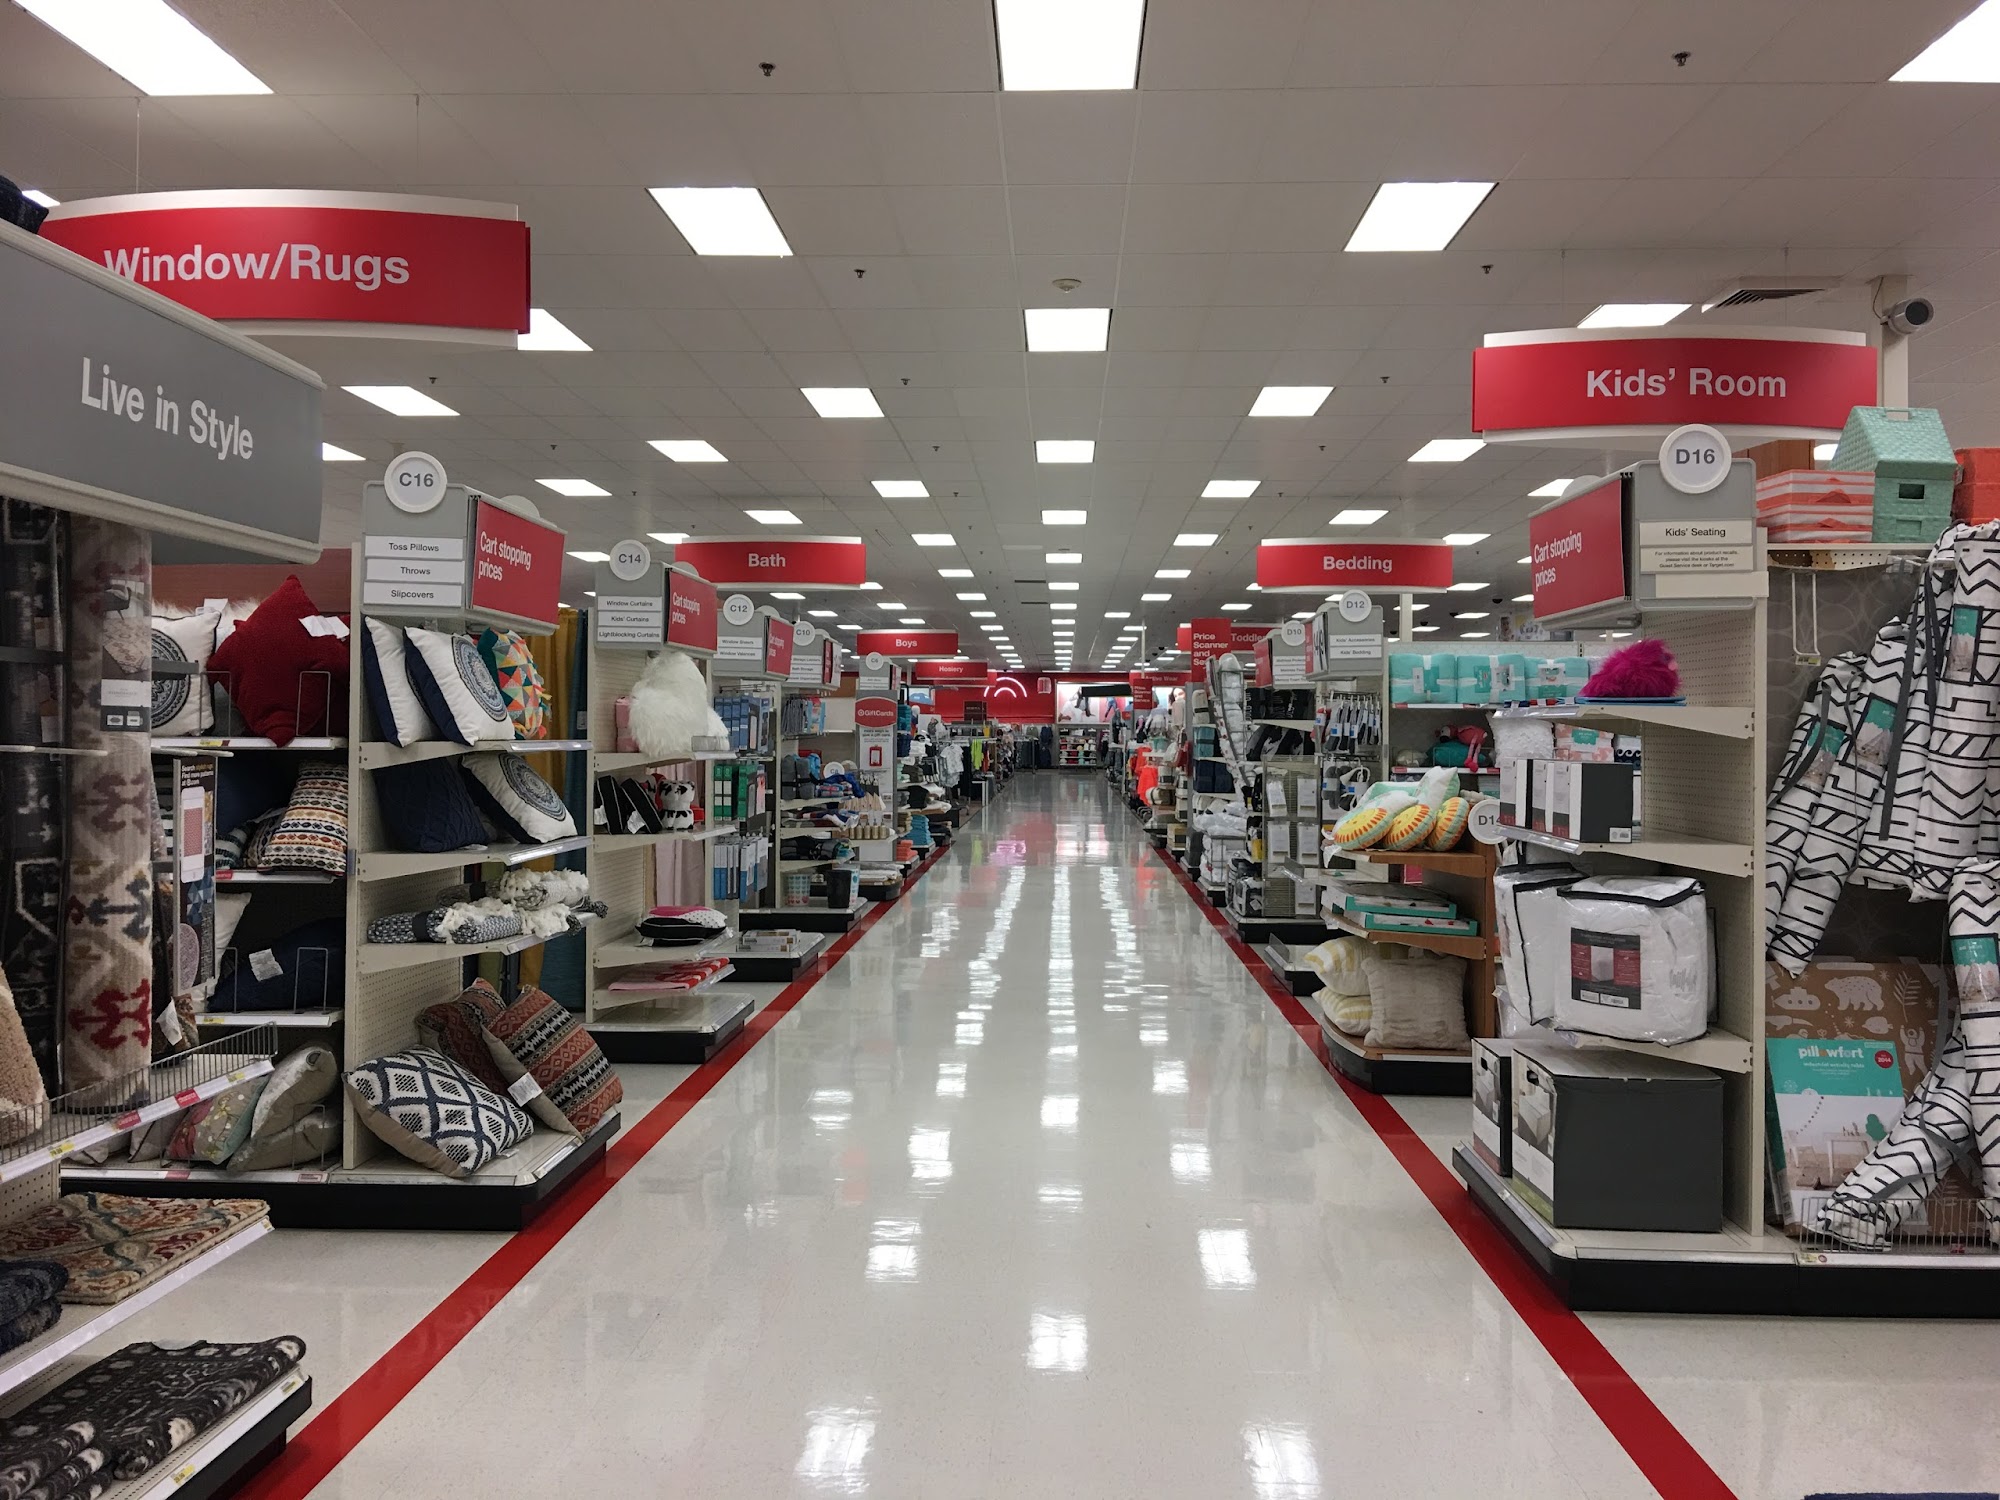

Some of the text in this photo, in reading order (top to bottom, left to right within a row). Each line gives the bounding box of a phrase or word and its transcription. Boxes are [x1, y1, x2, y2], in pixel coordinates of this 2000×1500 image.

[103, 243, 410, 291] Window/Rugs
[1586, 367, 1786, 398] Kids’ Room
[81, 357, 253, 461] Live in Style
[1675, 449, 1715, 465] D16
[399, 472, 434, 487] C16
[1665, 527, 1726, 538] Kids' Seating
[388, 542, 440, 552] Toss Pillows
[480, 531, 532, 572] Cart stopping
[1534, 530, 1582, 564] Cart stopping
[618, 553, 641, 564] C14
[748, 553, 786, 568] Bath
[1323, 556, 1392, 573] Bedding
[400, 566, 431, 576] Throws
[478, 557, 503, 581] prices
[1535, 566, 1556, 592] prices
[391, 589, 434, 600] Slipcovers
[730, 604, 748, 613] C12
[599, 631, 636, 639] Lightblocking
[895, 639, 918, 648] Boys
[1193, 641, 1229, 649] Scanner
[938, 665, 964, 673] Hosiery
